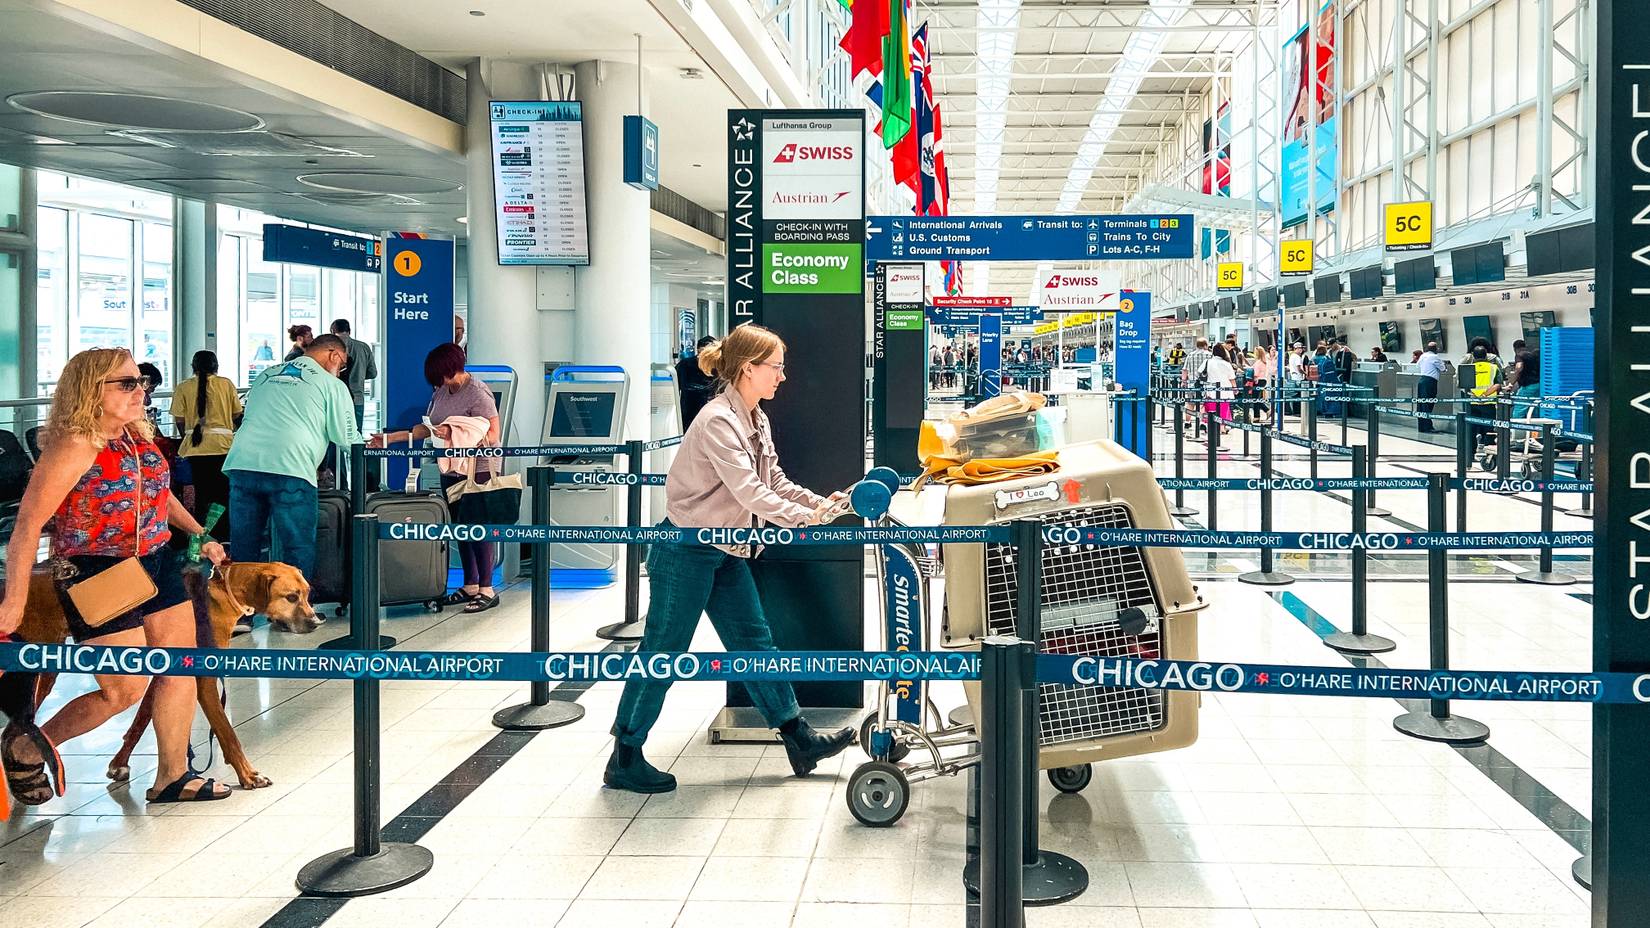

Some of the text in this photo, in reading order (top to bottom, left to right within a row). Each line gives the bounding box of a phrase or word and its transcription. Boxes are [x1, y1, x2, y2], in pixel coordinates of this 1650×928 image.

[809, 122, 832, 130] Group
[799, 146, 853, 160] SWISS
[772, 192, 827, 203] Austrian
[735, 149, 753, 289] ALLIANCE
[1104, 220, 1147, 228] Terminals
[1395, 215, 1421, 232] 5C
[776, 223, 848, 231] CHECK-IN WITH
[909, 221, 1003, 229] International Arrivals
[1037, 221, 1083, 229] Transit to:
[909, 234, 971, 242] U.S. Customs
[1104, 233, 1171, 242] Trains To City
[341, 240, 358, 250] Transit
[1103, 245, 1160, 254] Lots A-C, F-H
[909, 247, 990, 256] Ground Transport
[1287, 250, 1306, 263] 5C
[403, 257, 410, 270] 1
[772, 252, 849, 270] Economy
[772, 270, 818, 285] Class
[1223, 270, 1237, 280] 5C
[1062, 276, 1099, 286] SWISS
[394, 291, 429, 304] Start
[1044, 294, 1094, 305] Austrian
[394, 307, 429, 320] Here
[875, 276, 884, 359] STAR ALLIANCE
[1119, 321, 1134, 330] Bag
[1119, 329, 1138, 338] Drop
[407, 449, 435, 457] AIRPORT
[444, 448, 504, 459] CHICAGO
[573, 472, 638, 485] CHICAGO
[1196, 479, 1230, 488] AIRPORT
[1247, 478, 1314, 490] CHICAGO
[1327, 480, 1358, 488] O'HARE
[1463, 479, 1534, 492] CHICAGO
[1547, 483, 1578, 491] O'HARE
[389, 523, 987, 545] CHICAGO O'HARE INTERNATIONAL AIRPORT CHICAGO O'HARE INTERNATIONAL AIRPORT
[1101, 531, 1593, 550] O'HARE INTERNATIONAL AIRPORT CHICAGO O'HARE INTERNATIONAL AIRPOR
[18, 643, 171, 674] CHICAGO
[204, 654, 272, 672] O'HARE
[277, 656, 422, 673] INTERNATIONAL
[426, 658, 504, 673] AIRPORT
[544, 653, 700, 680] CHICAGO
[733, 657, 801, 673] O'HARE
[806, 657, 953, 673] INTERNATIONAL
[1072, 656, 1603, 696] CHICAGO O'HARE INTERNATIONAL AIRPORT
